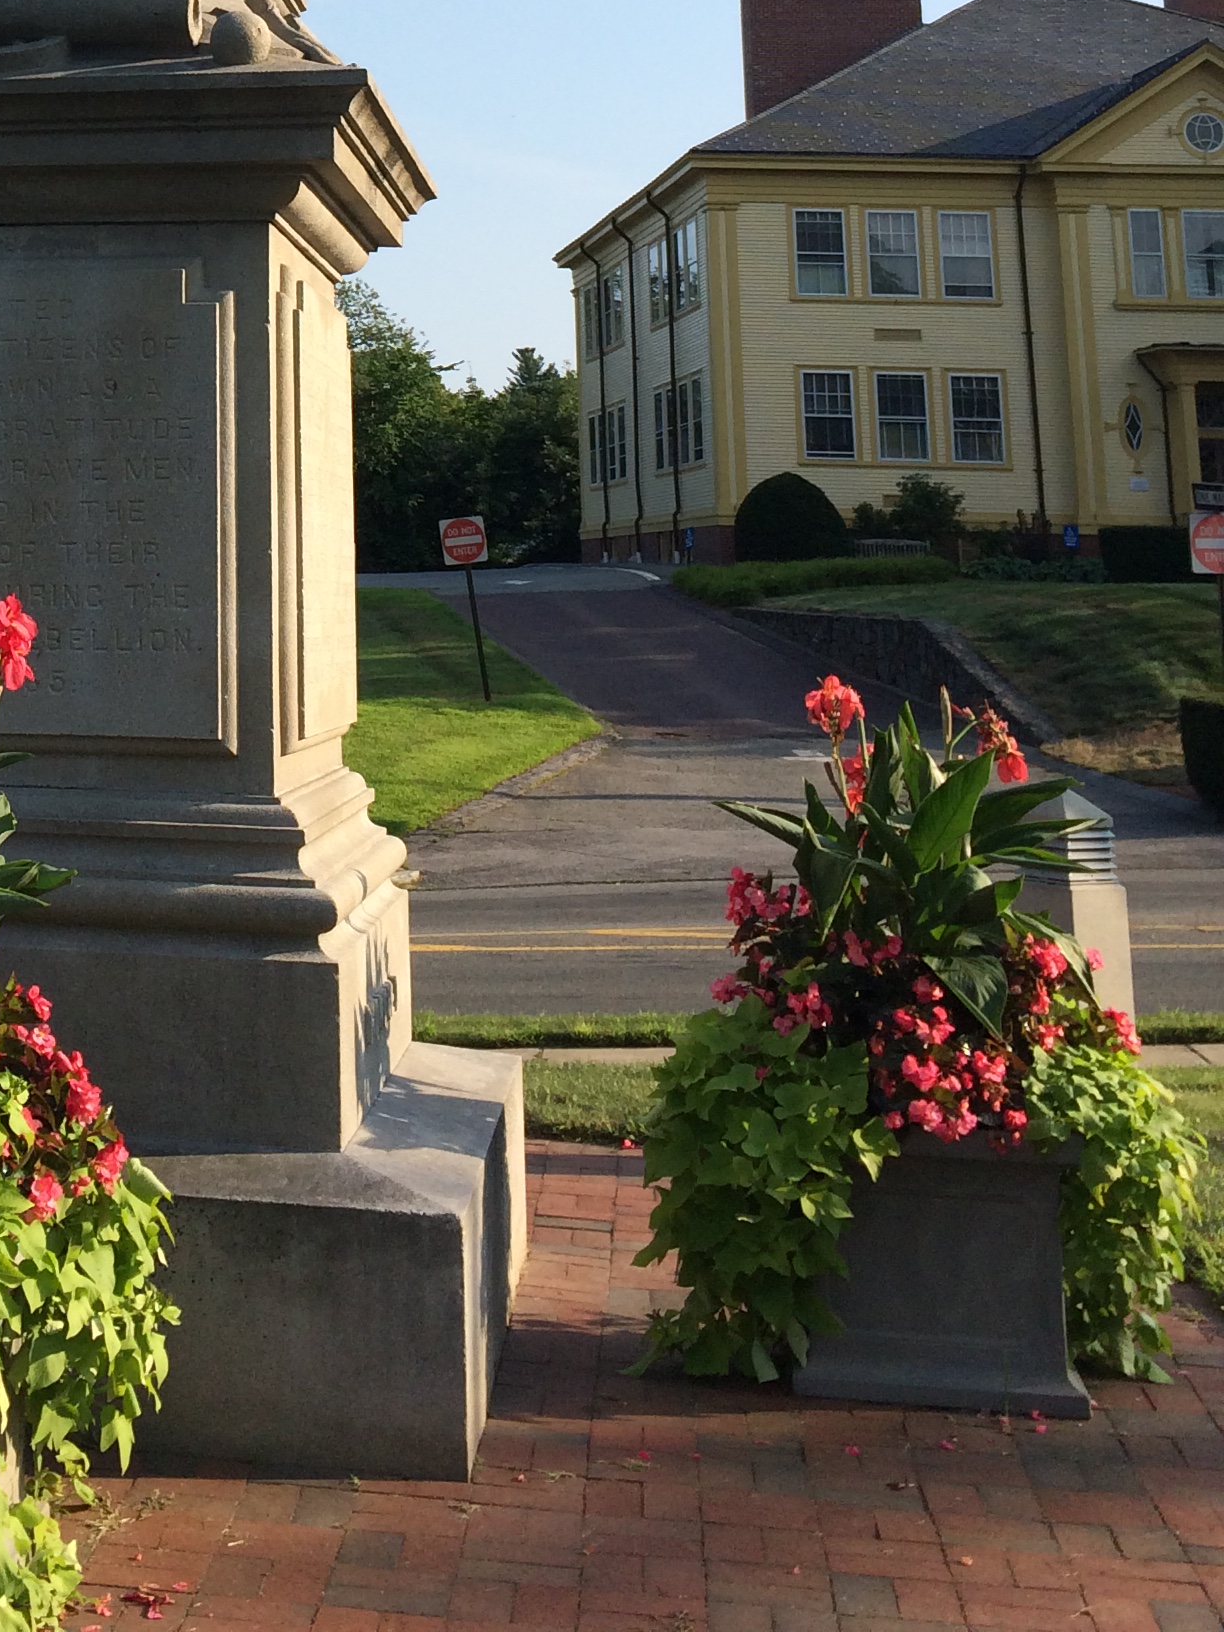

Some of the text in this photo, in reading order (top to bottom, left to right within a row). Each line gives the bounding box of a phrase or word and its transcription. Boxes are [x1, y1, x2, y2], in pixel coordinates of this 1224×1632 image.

[142, 335, 182, 360] OF
[31, 499, 58, 524] IN
[79, 499, 146, 523] THE
[447, 526, 476, 536] DO NOT
[57, 541, 161, 565] THEIR
[453, 546, 477, 556] ENTER
[124, 583, 190, 609] THE
